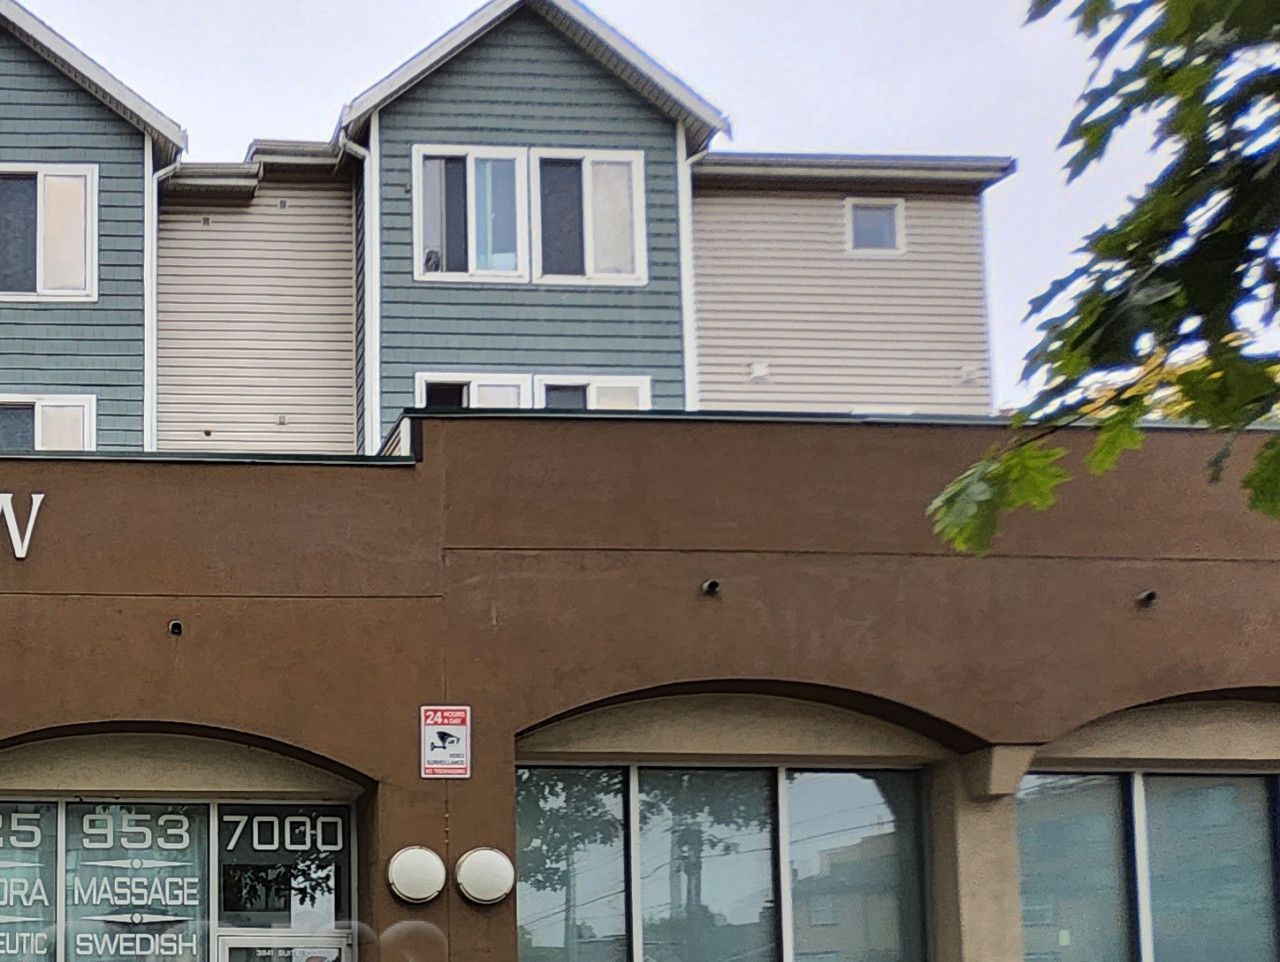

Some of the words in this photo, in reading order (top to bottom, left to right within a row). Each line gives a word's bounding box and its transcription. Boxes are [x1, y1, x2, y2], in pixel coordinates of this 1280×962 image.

[425, 711, 443, 724] 24
[82, 813, 190, 849] 953
[222, 815, 344, 851] 7000
[73, 876, 199, 906] MASSAGE
[75, 933, 197, 955] SWEDISH
